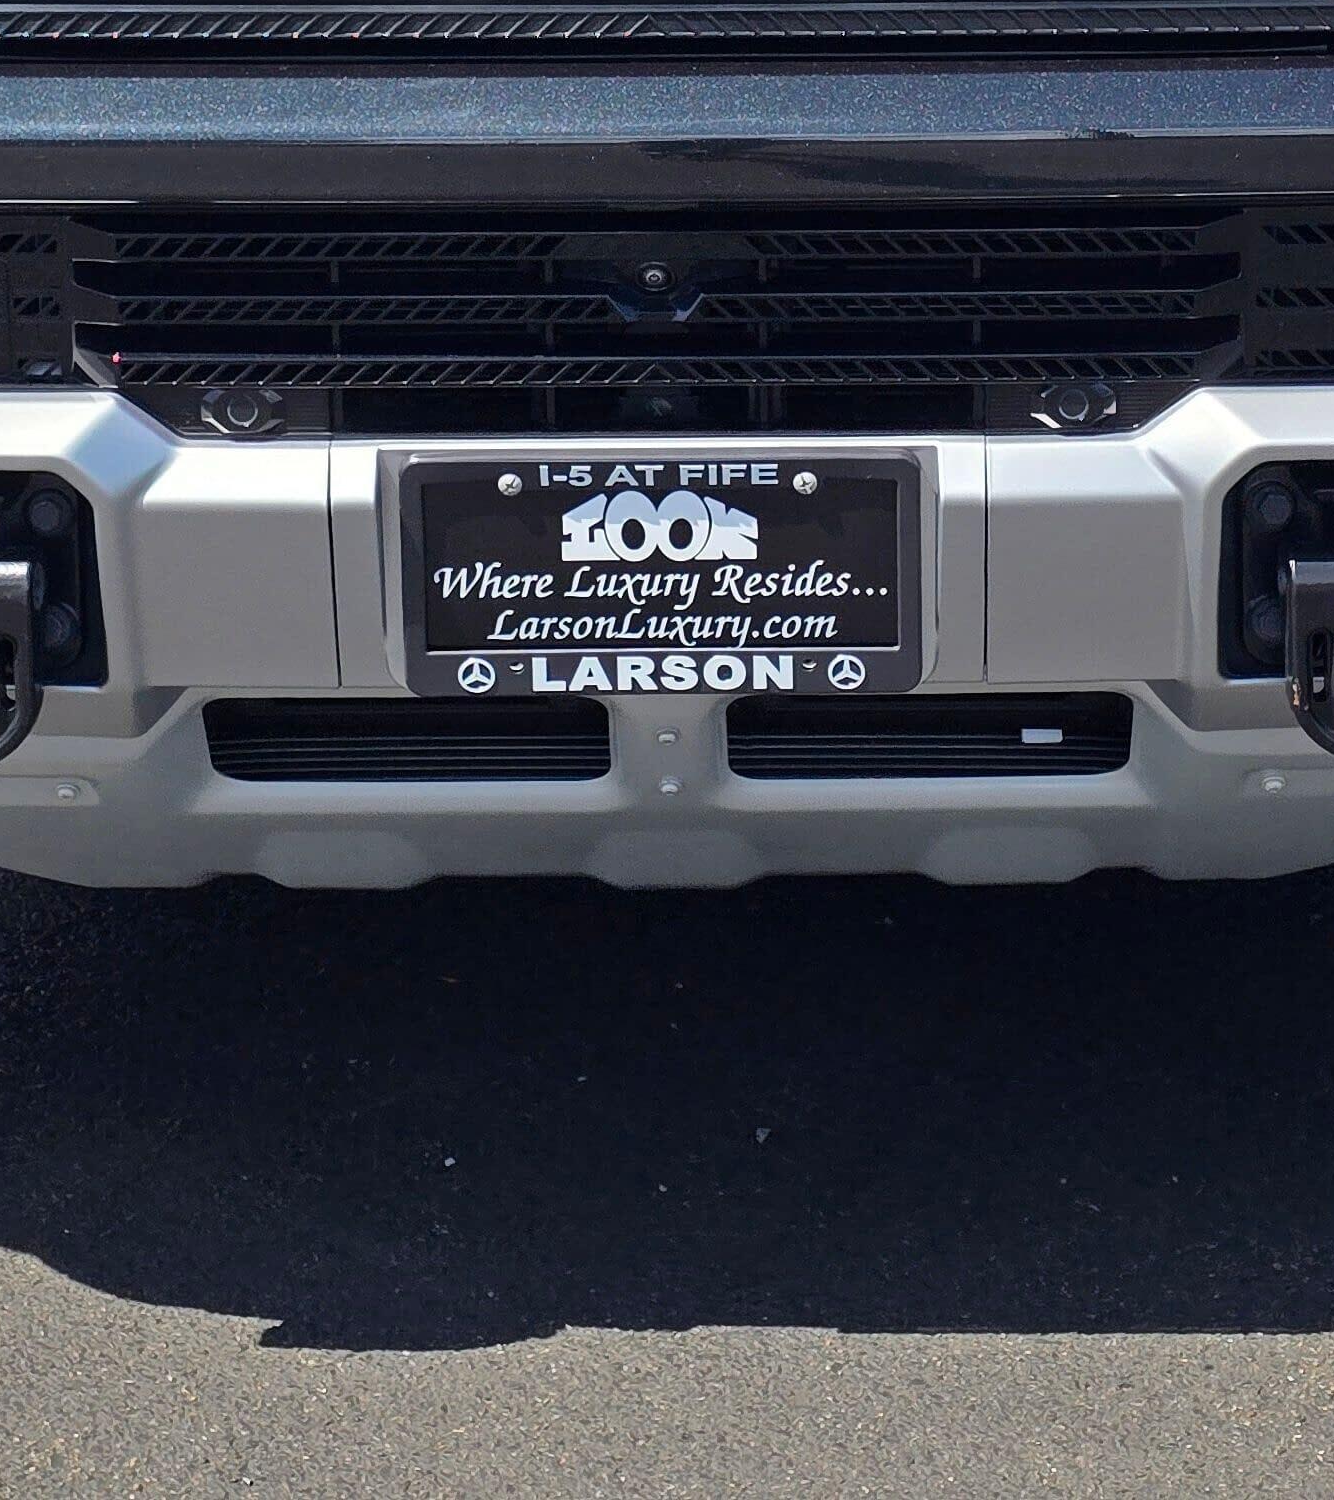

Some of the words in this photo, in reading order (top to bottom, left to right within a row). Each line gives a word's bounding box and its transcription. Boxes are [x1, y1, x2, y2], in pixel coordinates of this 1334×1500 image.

[539, 465, 593, 488] I-5
[604, 464, 664, 487] AT
[678, 463, 779, 486] FIFE
[433, 562, 554, 599] Where
[563, 565, 701, 609] Luxury
[713, 559, 889, 602] Resides...
[486, 609, 838, 649] LarsonLuxury.com
[531, 655, 794, 693] LARSON
